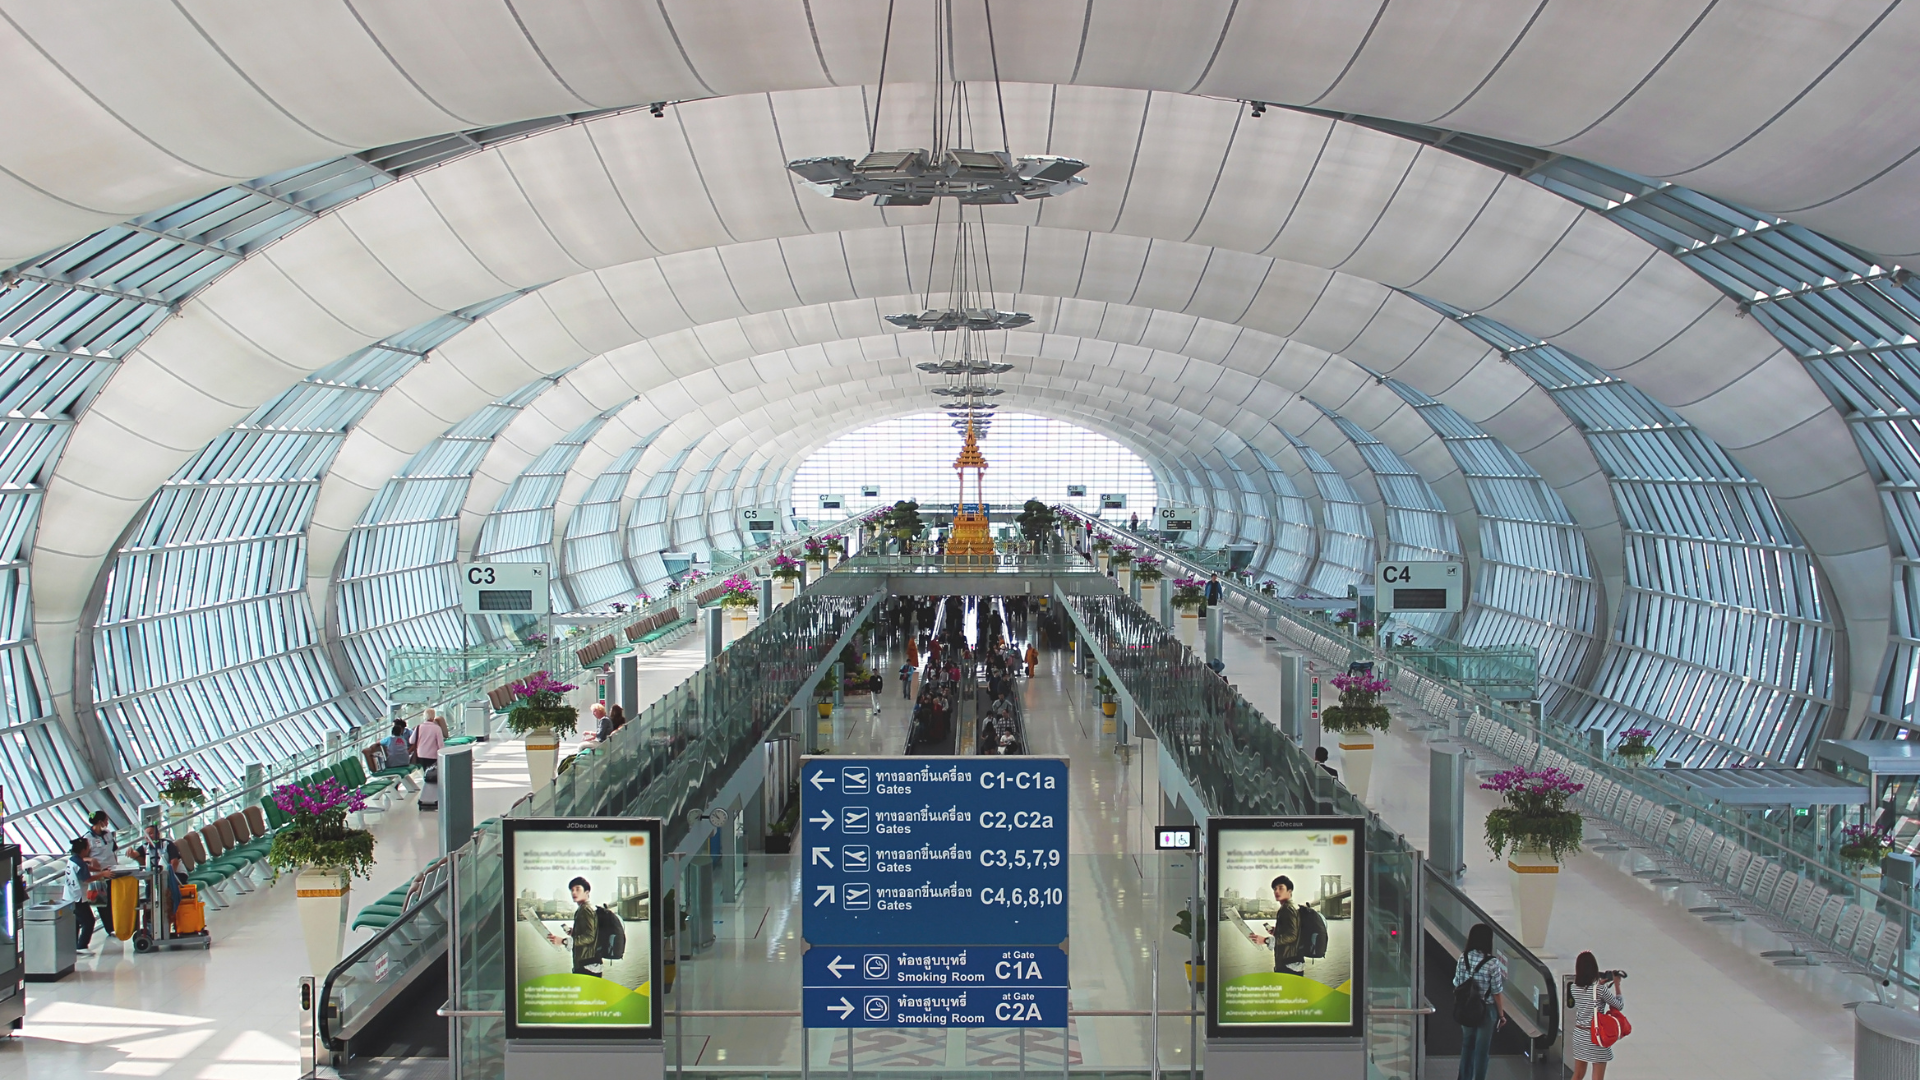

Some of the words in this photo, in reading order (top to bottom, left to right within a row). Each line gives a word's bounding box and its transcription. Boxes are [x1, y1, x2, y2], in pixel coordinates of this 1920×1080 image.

[744, 510, 758, 519] C5
[1161, 509, 1176, 519] C6
[467, 567, 496, 585] C3
[1382, 565, 1411, 584] C4
[876, 765, 972, 782] ทางออกขึ้นเครื่อง
[980, 772, 1056, 790] C1-C1a
[877, 784, 912, 795] Gates
[875, 804, 971, 822] ทางออกขึ้นเครื่อง
[980, 811, 1054, 832] C2,C2a
[876, 824, 911, 834] Gates
[876, 843, 972, 860] ทางออกขึ้นเครื่อง
[980, 849, 1061, 870] C3,5,7,9
[877, 862, 912, 873] Gates
[877, 881, 973, 898] ทางออกขึ้นเครื่อง
[980, 887, 1063, 908] C4,6,8,10
[877, 900, 913, 911] Gates
[897, 950, 967, 970] ห้องสูบบุหรี่
[1002, 951, 1011, 959] at
[1014, 951, 1035, 959] Gate
[897, 972, 947, 984] Smoking
[952, 972, 985, 982] Room
[995, 961, 1043, 980] C1A
[897, 991, 967, 1011] ห้องสูบบุหรี่
[1002, 992, 1011, 1000] at
[1014, 992, 1035, 1000] Gate
[897, 1013, 947, 1025] Smoking
[952, 1013, 985, 1023] Room
[995, 1002, 1043, 1021] C2A
